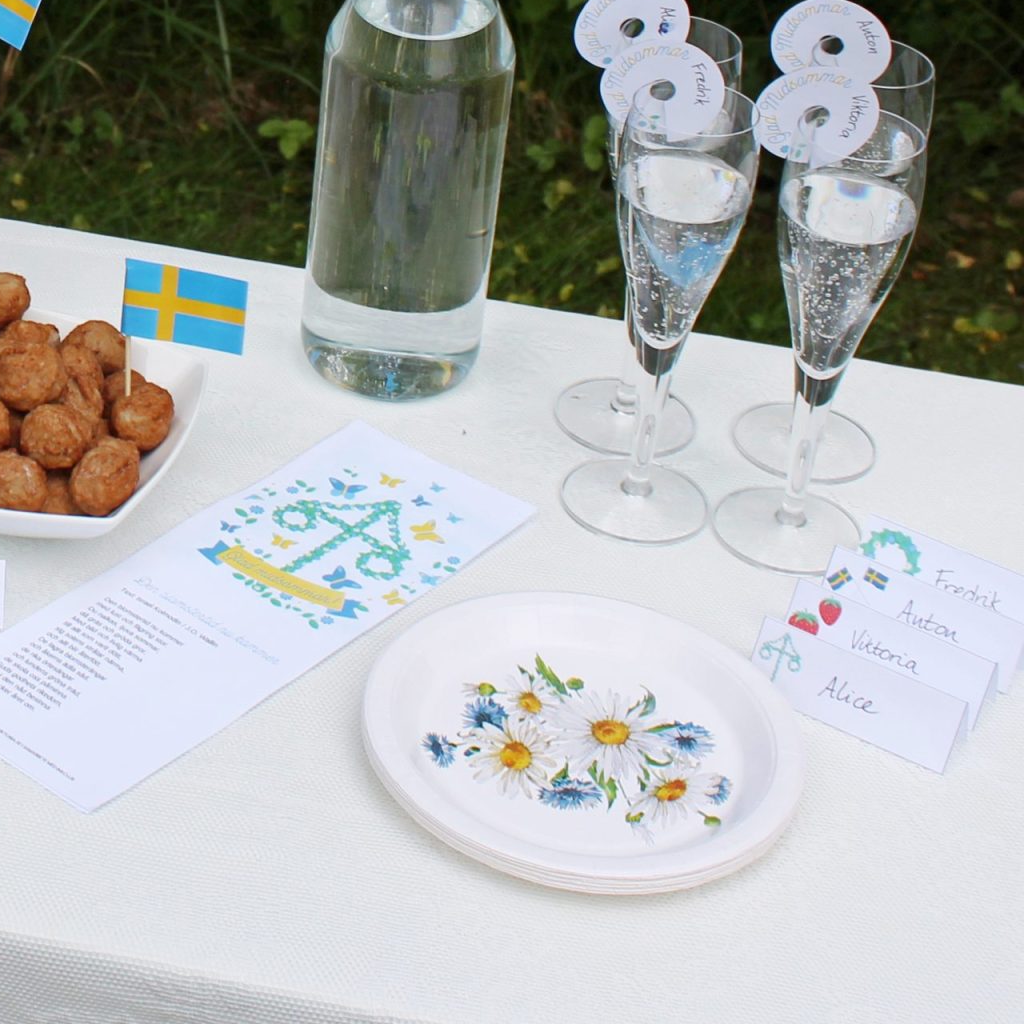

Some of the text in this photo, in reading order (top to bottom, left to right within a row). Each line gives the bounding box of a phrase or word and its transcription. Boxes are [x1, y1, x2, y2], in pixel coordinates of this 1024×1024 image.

[857, 20, 878, 54] Anton
[691, 62, 711, 106] Fredrik
[839, 95, 870, 139] Viktoria
[935, 569, 1002, 613] Fredrik
[896, 599, 959, 644] Anton
[852, 629, 920, 676] Viktoria
[817, 676, 880, 714] Alice
